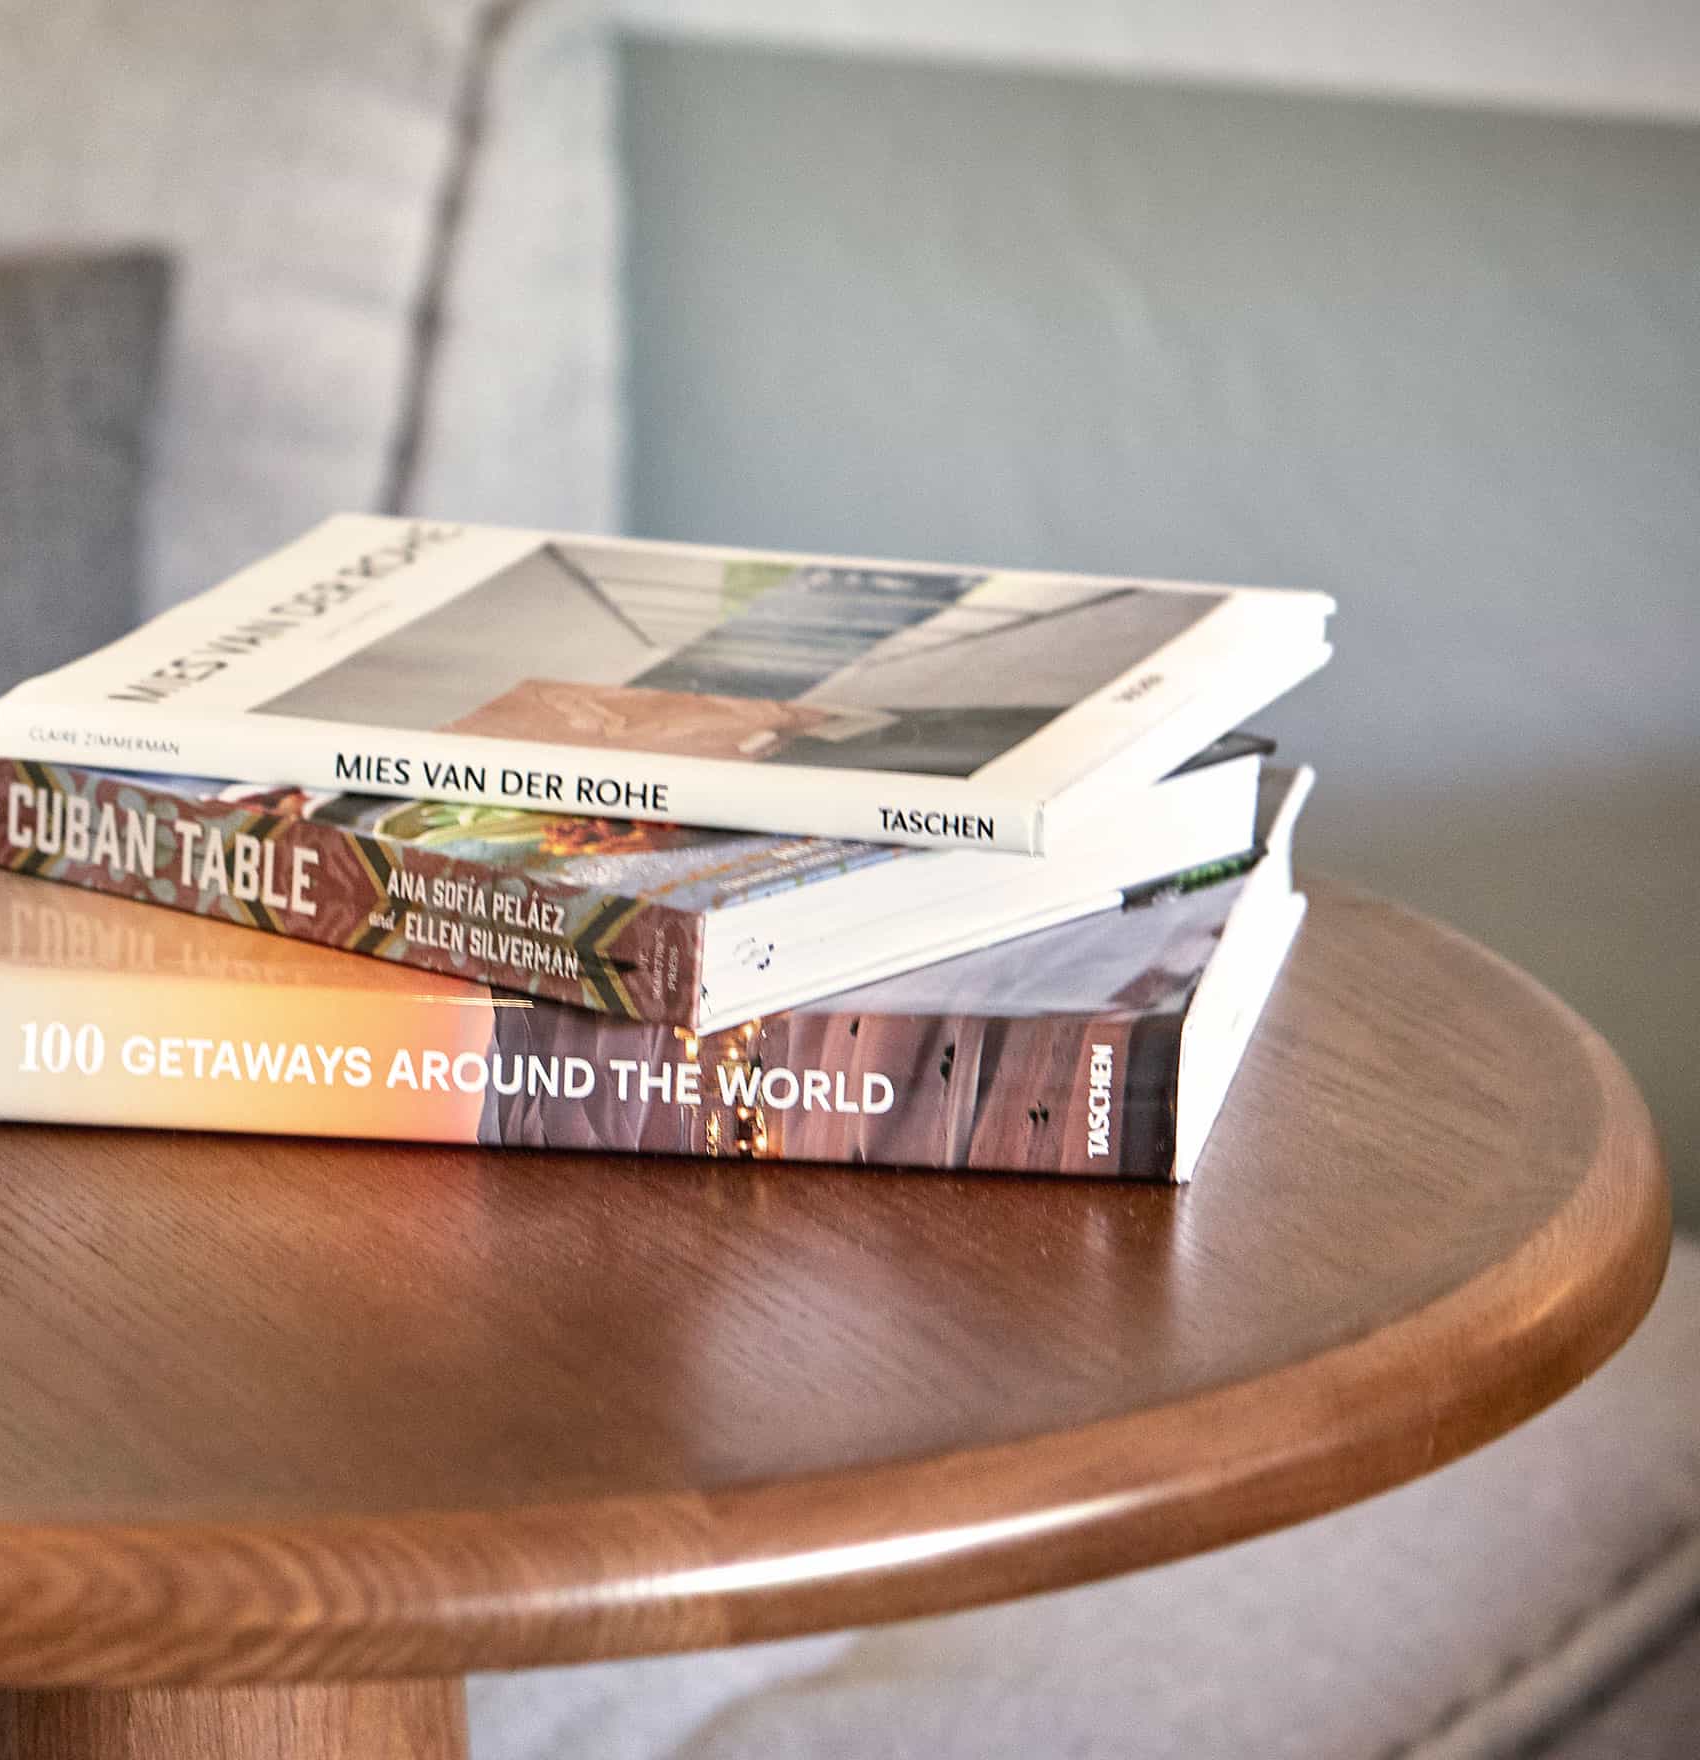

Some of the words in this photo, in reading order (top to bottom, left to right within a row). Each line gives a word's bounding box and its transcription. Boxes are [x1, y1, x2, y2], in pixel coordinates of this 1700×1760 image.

[29, 725, 77, 746] CLAIRE
[83, 729, 180, 756] ZIMMERMAN
[336, 752, 411, 786] MIES
[422, 761, 486, 793] VAN
[500, 769, 563, 800] DER
[575, 776, 669, 812] ROHE
[7, 782, 157, 879] CUBAN
[173, 819, 320, 917] TABLE
[878, 807, 994, 841] TASCHEN
[386, 867, 427, 905] ANA
[432, 874, 487, 919] SOFÍA
[368, 909, 396, 932] and
[405, 911, 464, 953] ELLEN
[469, 926, 579, 981] SILVERMAN
[18, 1020, 106, 1076] 100
[120, 1035, 373, 1088] GETAWAYS
[386, 1049, 595, 1101] AROUND
[609, 1058, 702, 1106] THE
[716, 1064, 896, 1115] WORLD
[1087, 1044, 1113, 1160] TASCHEN
